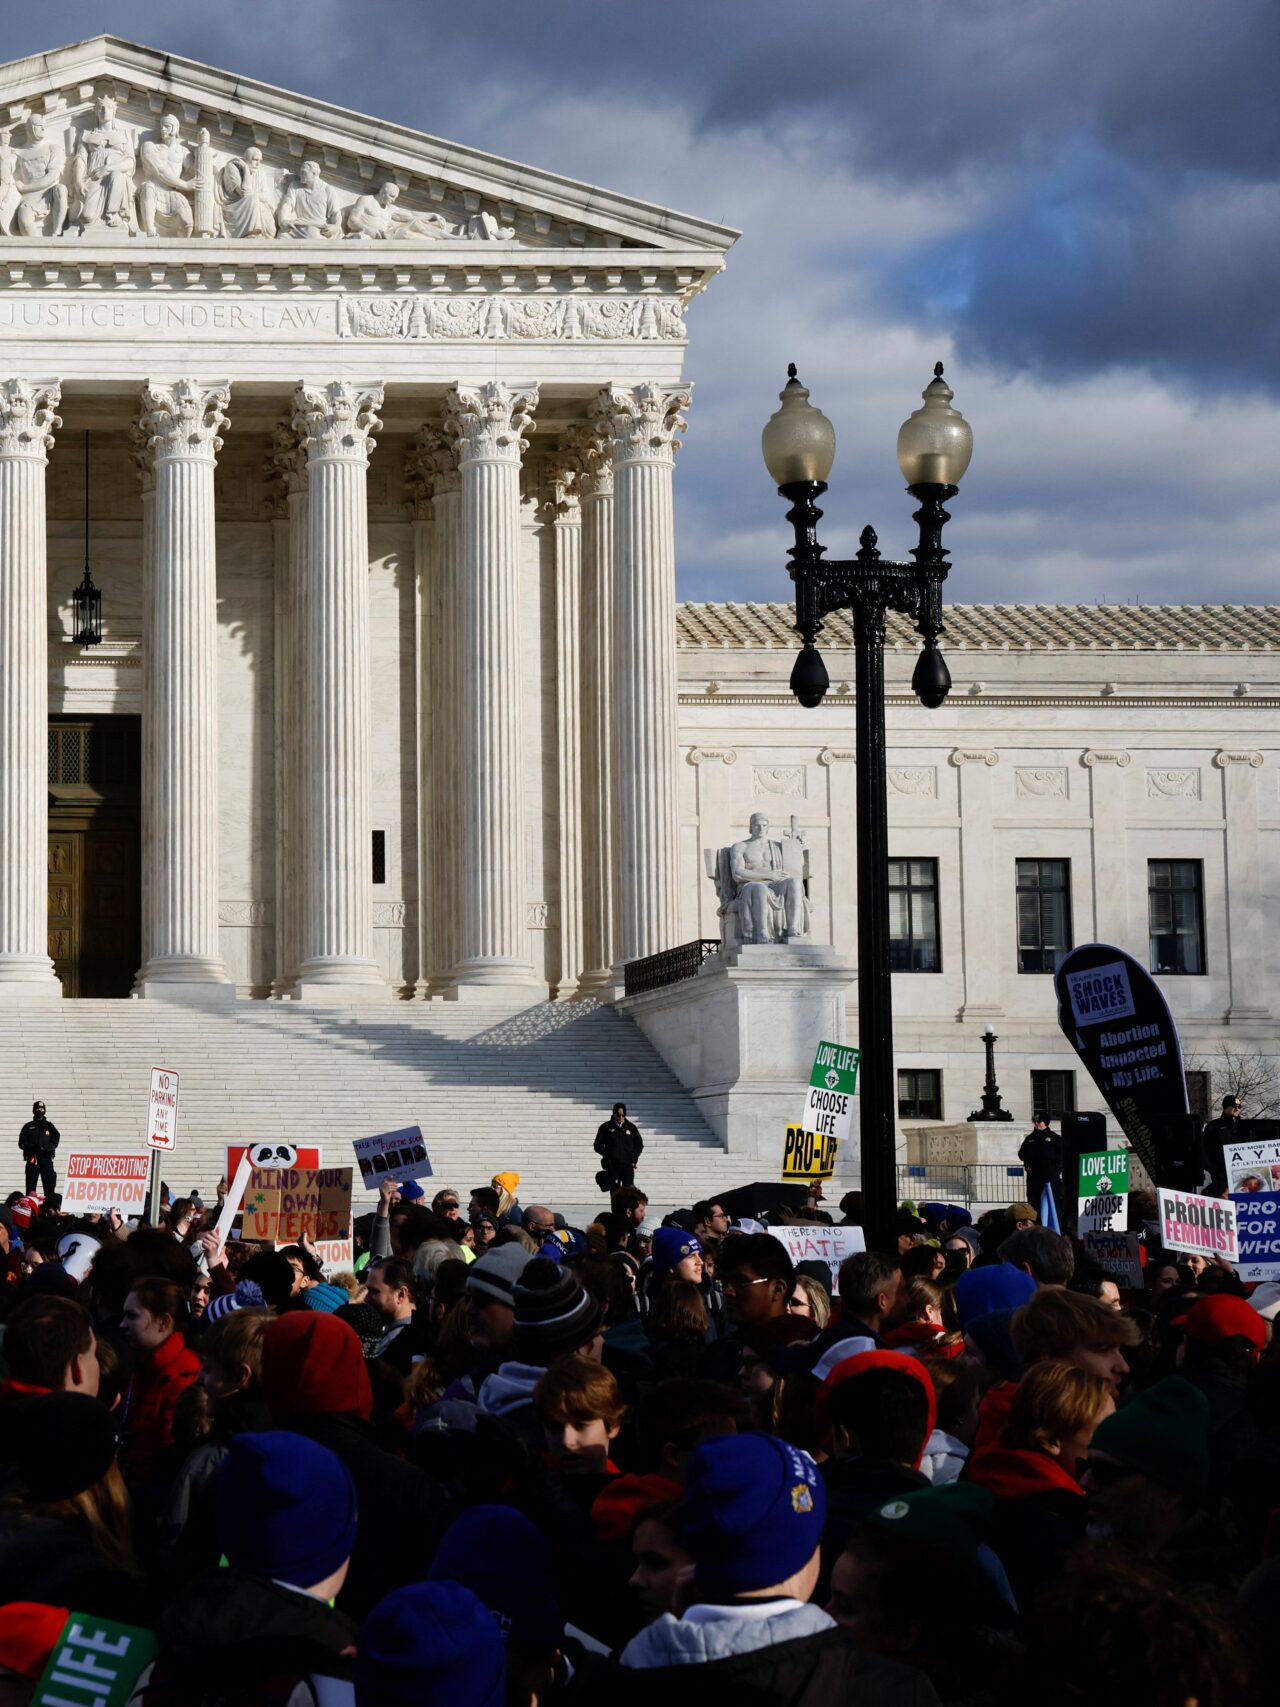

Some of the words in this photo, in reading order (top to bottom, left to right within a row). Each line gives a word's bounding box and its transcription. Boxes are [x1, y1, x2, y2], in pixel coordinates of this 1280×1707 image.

[0, 302, 126, 328] JUSTICE
[143, 303, 248, 329] UNDER
[261, 306, 321, 329] LAW
[1072, 974, 1125, 1000] SHOCK
[1076, 989, 1128, 1015] WAVES
[1100, 1023, 1160, 1049] Abortion
[816, 1044, 838, 1069] LOVE
[838, 1049, 860, 1073] LIFE
[158, 1075, 170, 1090] NO
[1112, 1071, 1134, 1088] My
[1136, 1065, 1164, 1084] Life.
[151, 1090, 176, 1108] PARKING
[810, 1089, 849, 1116] CHOOSE
[156, 1107, 169, 1120] ANY
[815, 1111, 837, 1136] LIFE
[154, 1119, 169, 1134] TIME
[782, 1127, 839, 1173] PRO-LIFE
[70, 1157, 91, 1177] STOP
[91, 1157, 148, 1177] PROSECUTING
[1082, 1156, 1106, 1177] LOVE
[1107, 1154, 1127, 1175] LIFE
[251, 1168, 300, 1190] MIND
[305, 1168, 343, 1189] YOUR
[65, 1181, 145, 1203] ABORTION
[282, 1193, 322, 1213] OWN
[1186, 1196, 1206, 1207] AM
[1212, 1200, 1221, 1209] A
[1084, 1195, 1123, 1217] CHOOSE
[1163, 1198, 1234, 1233] PROLIFE
[254, 1209, 341, 1239] UTERUS
[822, 1228, 842, 1237] NO
[1093, 1216, 1114, 1232] LIFE
[1236, 1220, 1277, 1235] FOR
[1165, 1218, 1236, 1253] FEMINIST
[788, 1238, 847, 1258] HATE
[40, 1623, 132, 1707] LIFE
